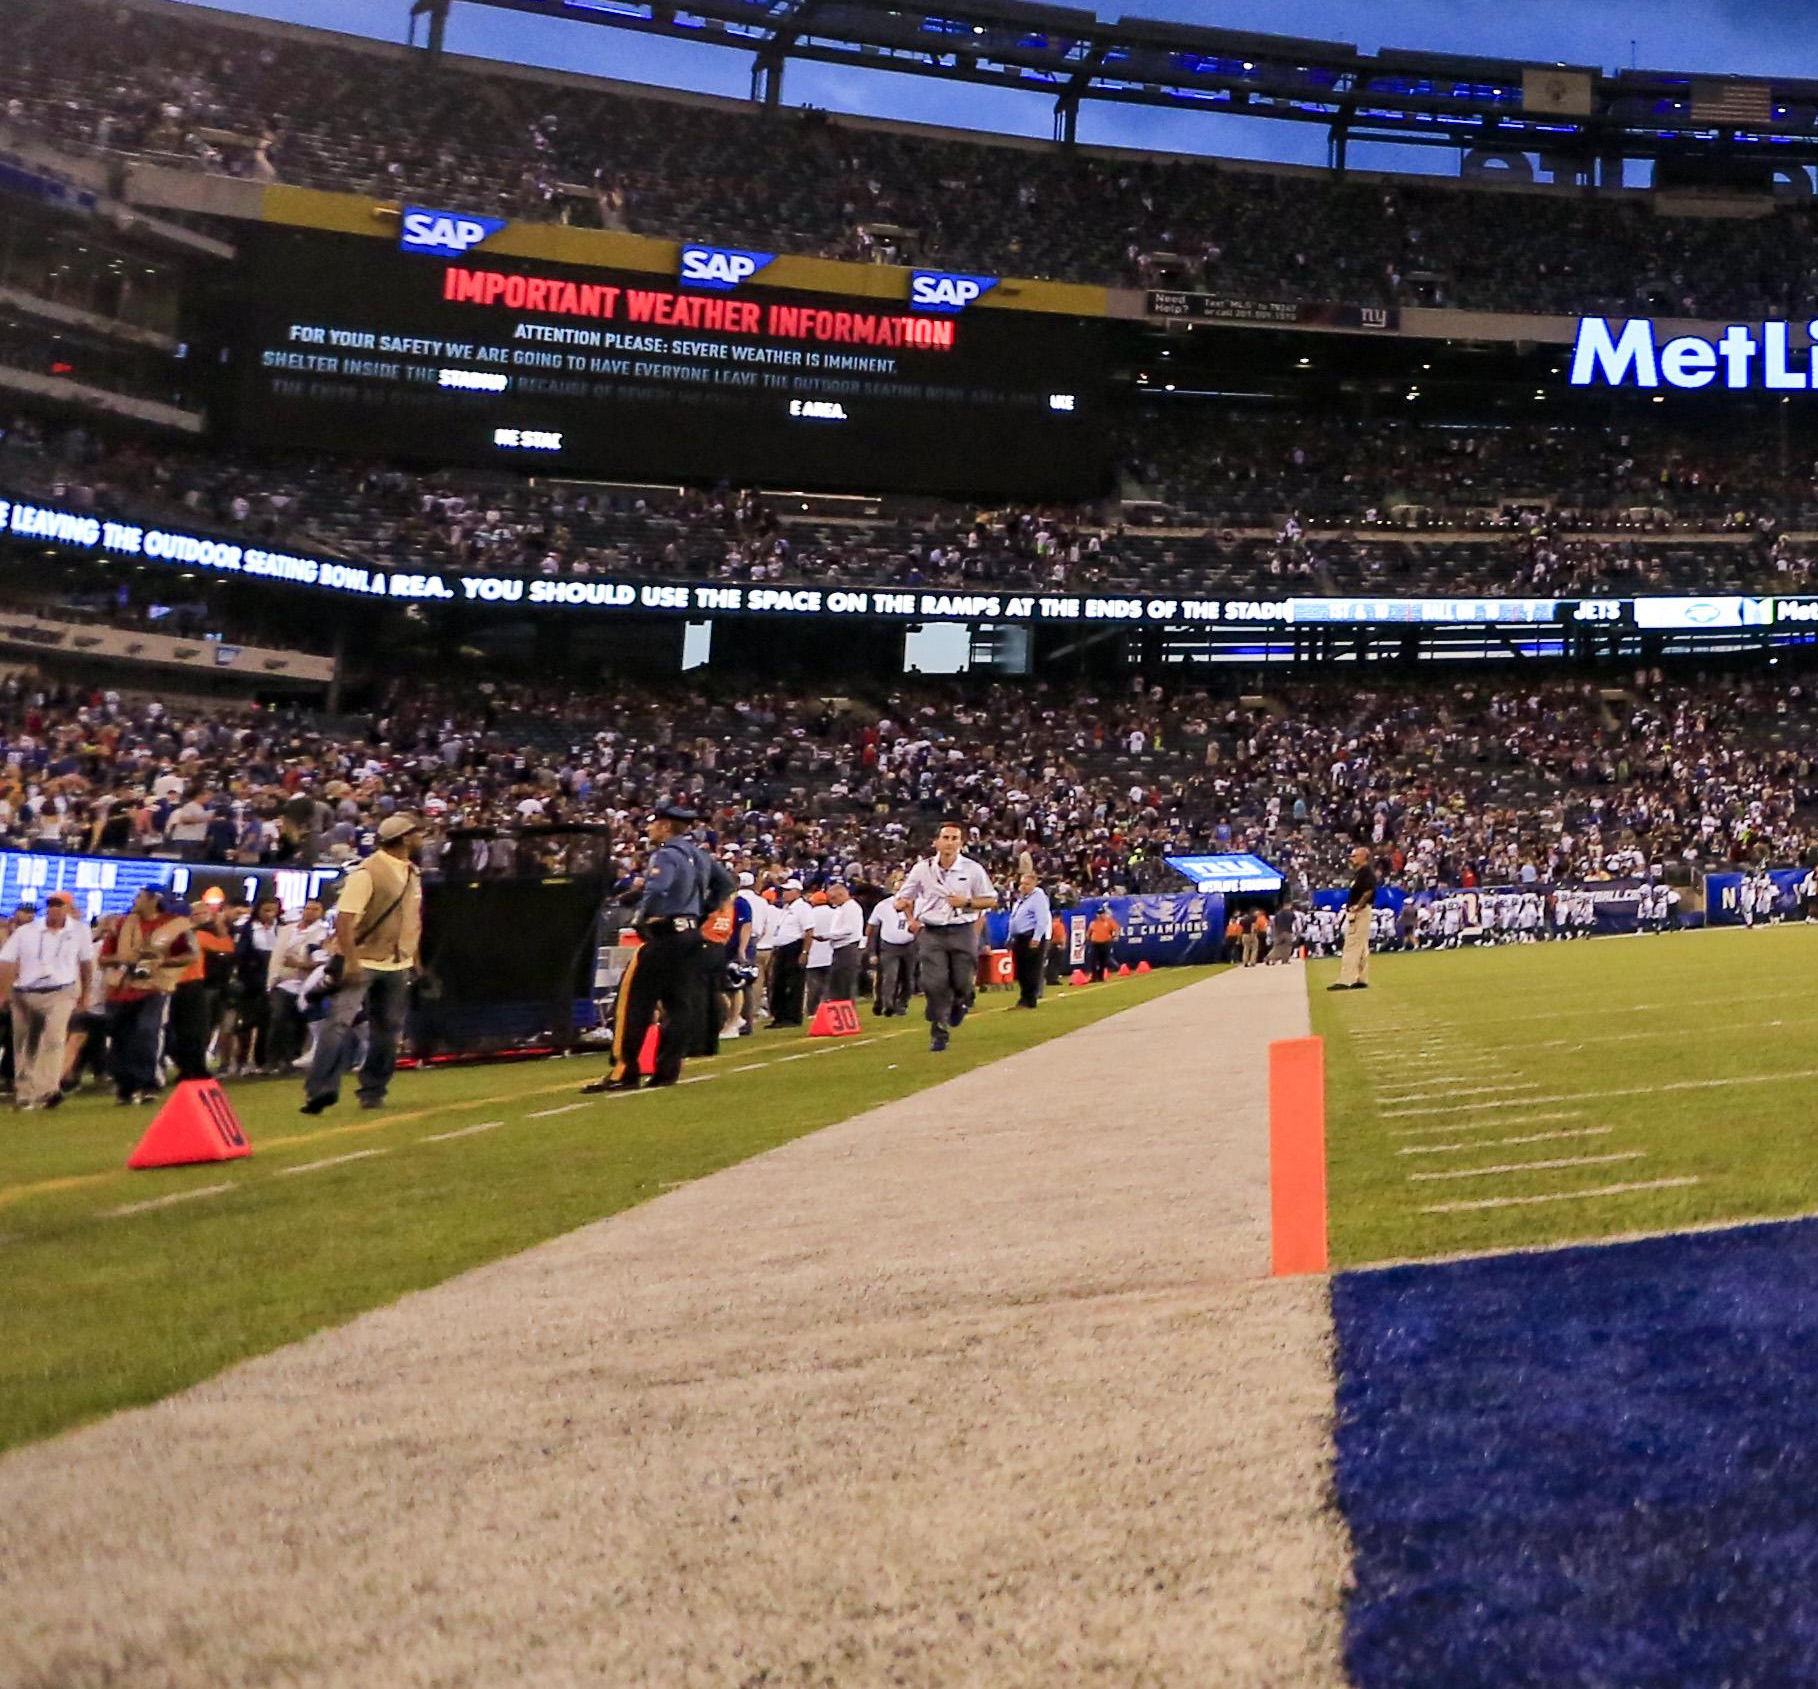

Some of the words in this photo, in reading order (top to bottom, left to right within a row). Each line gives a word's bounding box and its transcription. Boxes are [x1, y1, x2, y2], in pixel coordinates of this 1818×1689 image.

[403, 213, 485, 251] SAP
[682, 249, 756, 286] SAP
[444, 267, 620, 318] IMPORTANT
[626, 289, 759, 334] WEATHER
[768, 304, 955, 352] INFORMATION
[912, 276, 980, 306] SAP
[262, 350, 339, 373] SHELTER
[343, 357, 400, 380] INSIDE
[289, 325, 325, 343] FOR
[329, 329, 375, 349] YOUR
[379, 336, 442, 356] SAFETY
[445, 342, 473, 360] WE
[476, 346, 509, 364] ARE
[513, 350, 562, 369] GOING
[566, 355, 585, 370] TO
[590, 358, 630, 375] HAVE
[635, 362, 710, 382] EVERYONE
[714, 370, 757, 387] LEAVE
[763, 374, 788, 389] THE
[513, 324, 600, 347] ATTENTION
[604, 333, 668, 353] PLEASE:
[672, 341, 728, 359] SEVERE
[732, 346, 801, 366] WEATHER
[806, 353, 820, 367] IS
[824, 355, 897, 373] IMMINENT.
[10, 504, 101, 548] LEAVING
[102, 521, 143, 553] THE
[143, 529, 245, 572] OUTDOOR
[243, 547, 321, 585] SEATING
[318, 562, 373, 594] BOWL
[461, 576, 525, 602] YOU
[527, 579, 636, 606] SHOULD
[640, 585, 690, 609] USE
[694, 587, 742, 610] THE
[746, 589, 822, 612] SPACE
[826, 590, 868, 613] ON
[873, 593, 915, 614] THE
[920, 595, 1001, 617] RAMPS
[1005, 597, 1037, 617] AT
[1039, 598, 1081, 618] THE
[1084, 598, 1144, 619] ENDS
[1146, 598, 1178, 619] OF
[1181, 600, 1220, 620] THE
[1573, 600, 1621, 621] JETS
[1140, 920, 1209, 936] CHAMPIONS
[827, 1003, 858, 1032] 30
[198, 1086, 245, 1148] 10
